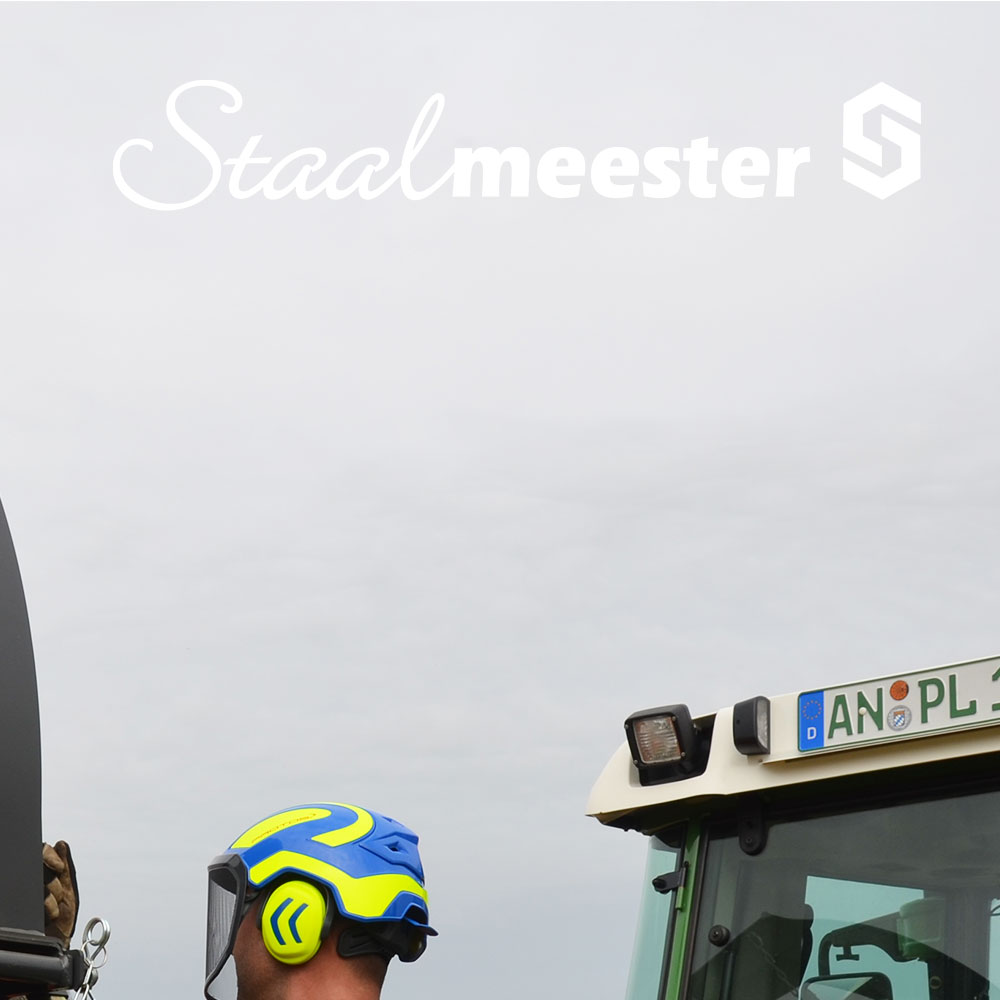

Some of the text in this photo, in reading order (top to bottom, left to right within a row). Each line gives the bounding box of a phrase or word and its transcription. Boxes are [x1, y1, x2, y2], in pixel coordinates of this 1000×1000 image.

[827, 687, 884, 739] AN
[918, 674, 977, 724] PL
[807, 726, 817, 740] D
